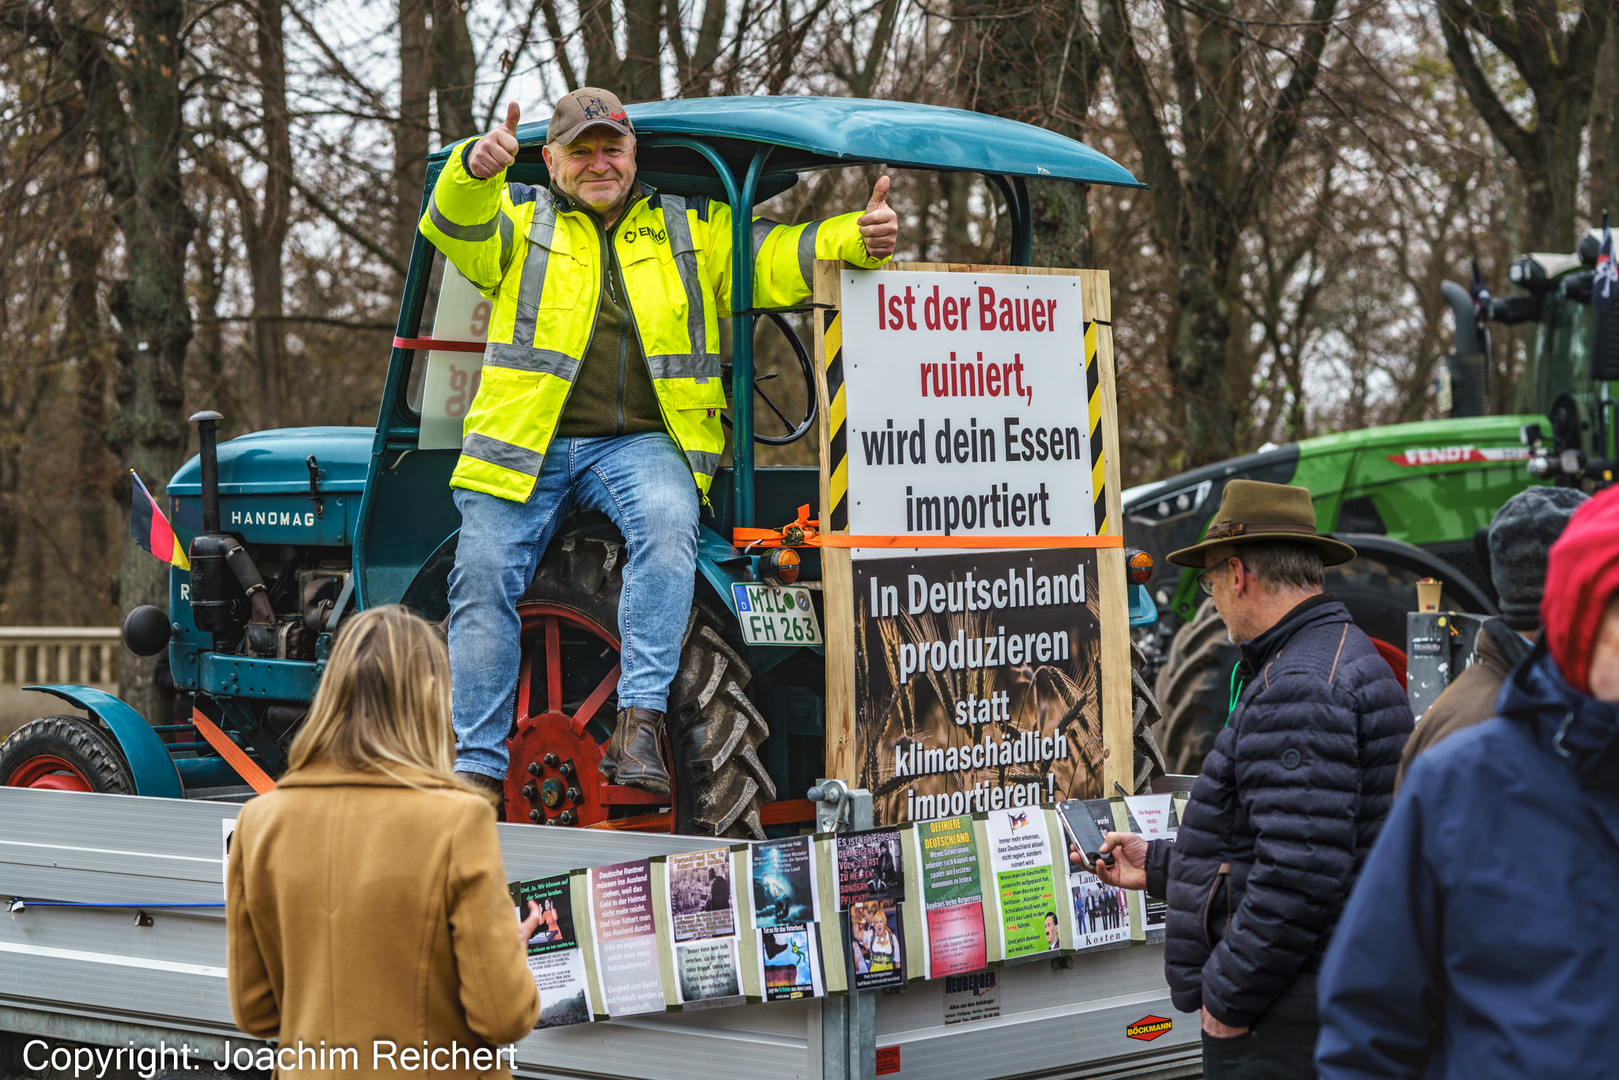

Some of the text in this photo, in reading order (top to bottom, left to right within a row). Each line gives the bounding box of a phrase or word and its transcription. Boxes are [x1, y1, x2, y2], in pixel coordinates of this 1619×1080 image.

[878, 284, 1057, 332] Ist der Bauer
[921, 352, 1032, 406] ruiniert,
[862, 417, 1080, 465] wird dein Essen
[1404, 445, 1474, 464] FENDT
[906, 483, 1050, 536] importiert
[232, 511, 314, 526] HANOMAG
[870, 564, 1085, 617] In Deutschland
[749, 588, 786, 613] MIL
[750, 616, 815, 640] FH 263
[900, 626, 1069, 683] produzieren
[956, 690, 1010, 725] statt
[896, 729, 1067, 777] klimaschädlich
[908, 781, 1040, 820] importieren
[930, 818, 961, 833] DEFINIERE
[875, 832, 900, 843] EGOISMUS
[924, 832, 971, 849] DEUTSCHLAND:
[839, 847, 879, 858] DEM EIGENEN
[944, 847, 969, 856] Generation
[839, 858, 879, 870] VOLK ZUERST
[925, 861, 943, 869] arbeitet
[599, 866, 644, 879] Deutsche Rentner
[840, 874, 848, 882] ZU
[597, 881, 616, 889] müssen
[626, 874, 647, 884] Ausland
[841, 883, 868, 893] SONDERN
[602, 889, 620, 898] ziehen,
[621, 886, 632, 894] weil
[628, 895, 646, 904] Heimat
[616, 907, 628, 915] mehr
[613, 927, 633, 936] Ausland
[634, 924, 651, 932] durch!
[624, 939, 651, 949] eigentlich
[1086, 932, 1120, 945] Kosten
[608, 960, 650, 972] Nationalhymne?
[608, 984, 630, 993] Einigkeit
[1128, 1022, 1171, 1036] BÖCKMANN
